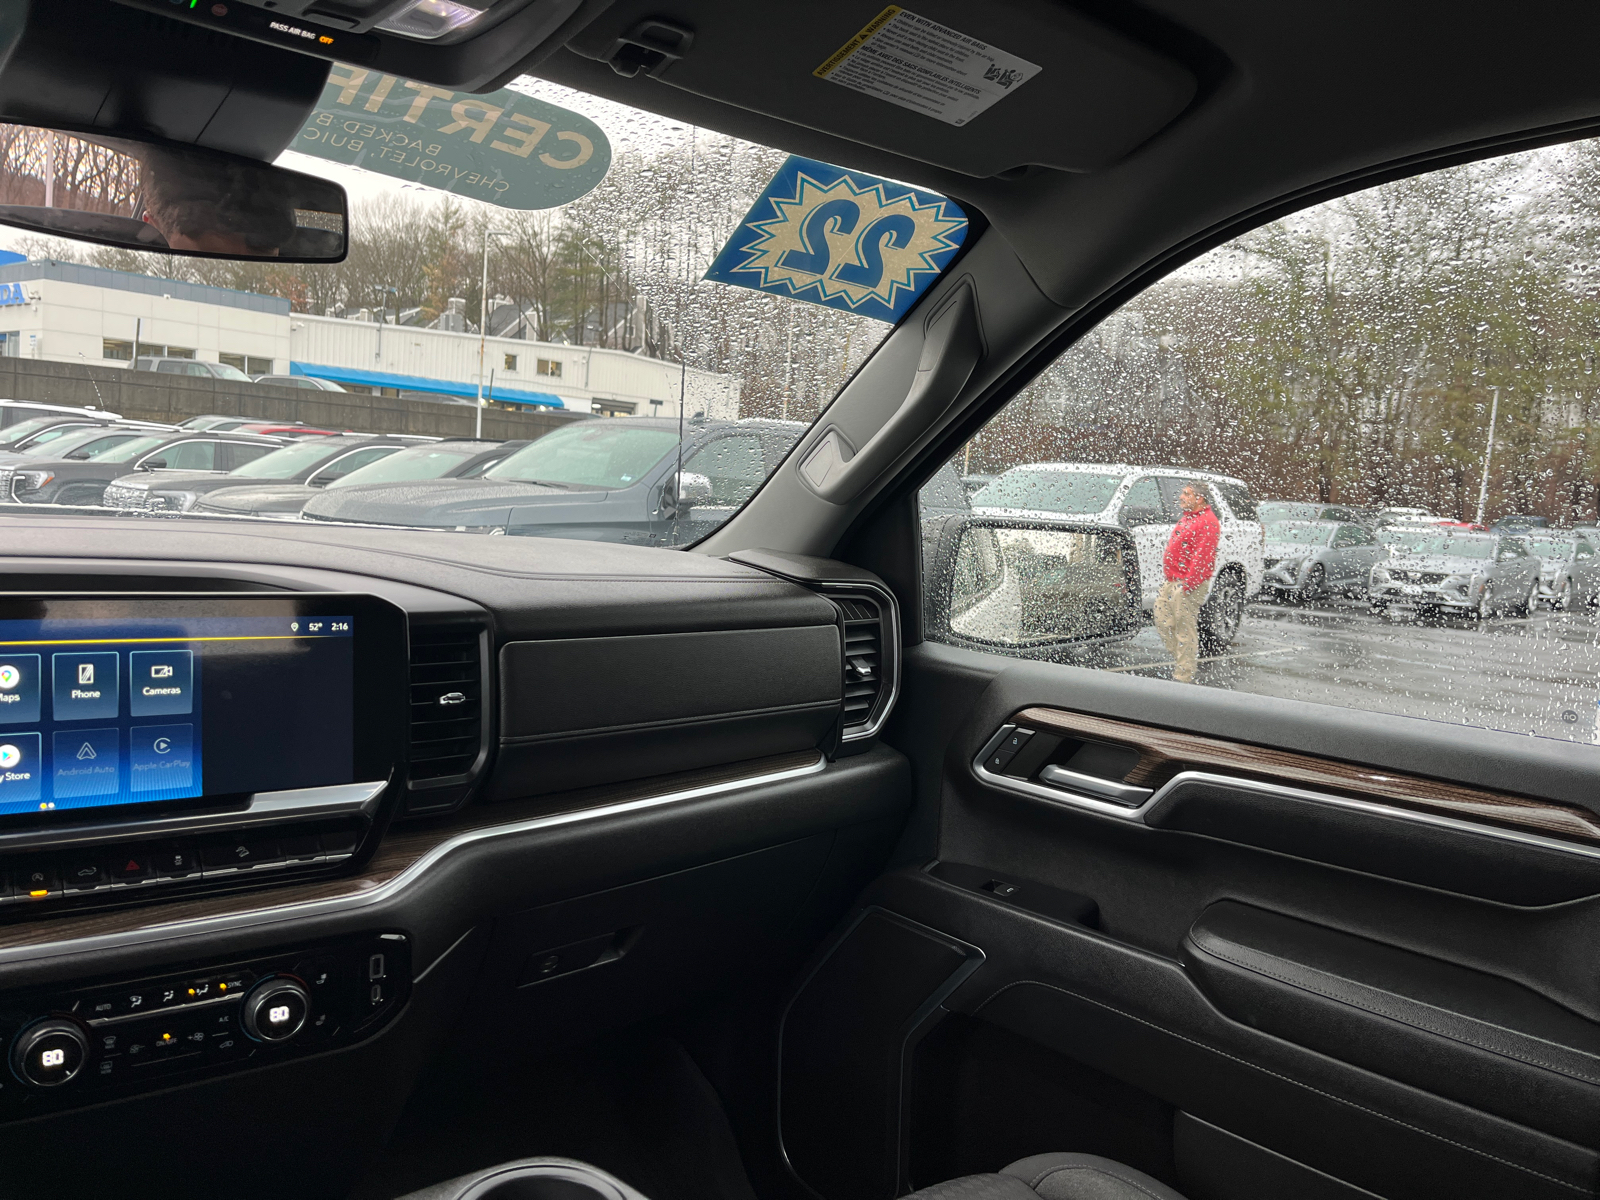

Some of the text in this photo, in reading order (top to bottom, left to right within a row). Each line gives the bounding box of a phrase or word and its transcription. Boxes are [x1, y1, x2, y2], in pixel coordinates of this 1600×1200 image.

[867, 9, 895, 33] WARNING
[270, 21, 334, 44] PASS AIR BAG OFF
[899, 11, 916, 20] EVEN
[915, 18, 932, 27] WITH
[930, 24, 962, 39] ADVANCED
[970, 40, 988, 50] BAGS
[890, 56, 905, 64] DES
[902, 61, 919, 69] SACS
[308, 622, 348, 631] 52° 2:16
[72, 688, 100, 699] Phone
[143, 685, 181, 696] Cameras
[58, 765, 115, 777] Android Auto
[133, 759, 190, 772] Apple CarPlay
[6, 772, 30, 781] Store
[227, 980, 242, 988] SYNC
